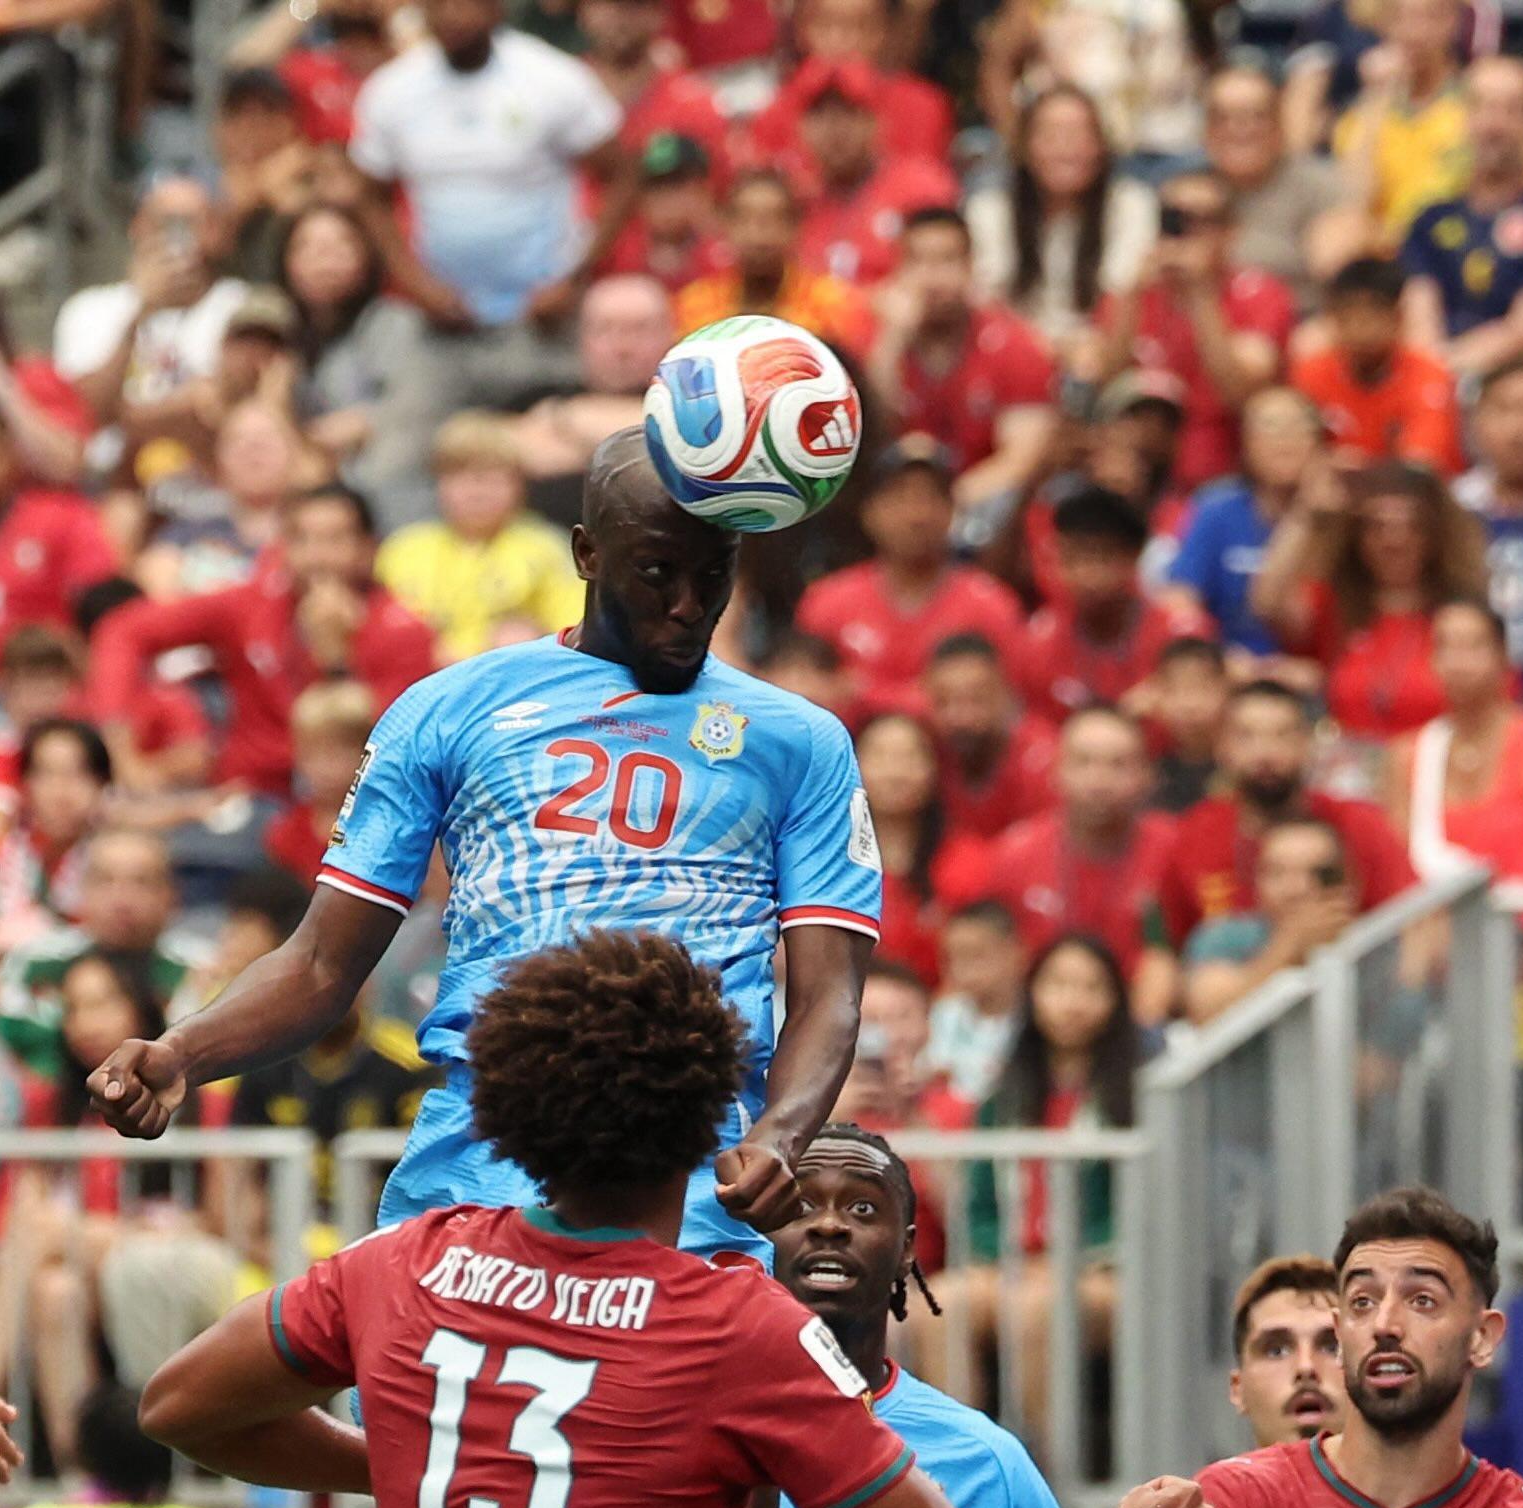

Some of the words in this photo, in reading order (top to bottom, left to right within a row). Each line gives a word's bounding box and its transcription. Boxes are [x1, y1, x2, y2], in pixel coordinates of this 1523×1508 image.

[493, 717, 542, 731] umbro
[534, 738, 684, 852] 20
[419, 1246, 548, 1311] RENATO
[549, 1273, 655, 1330] VEIGA
